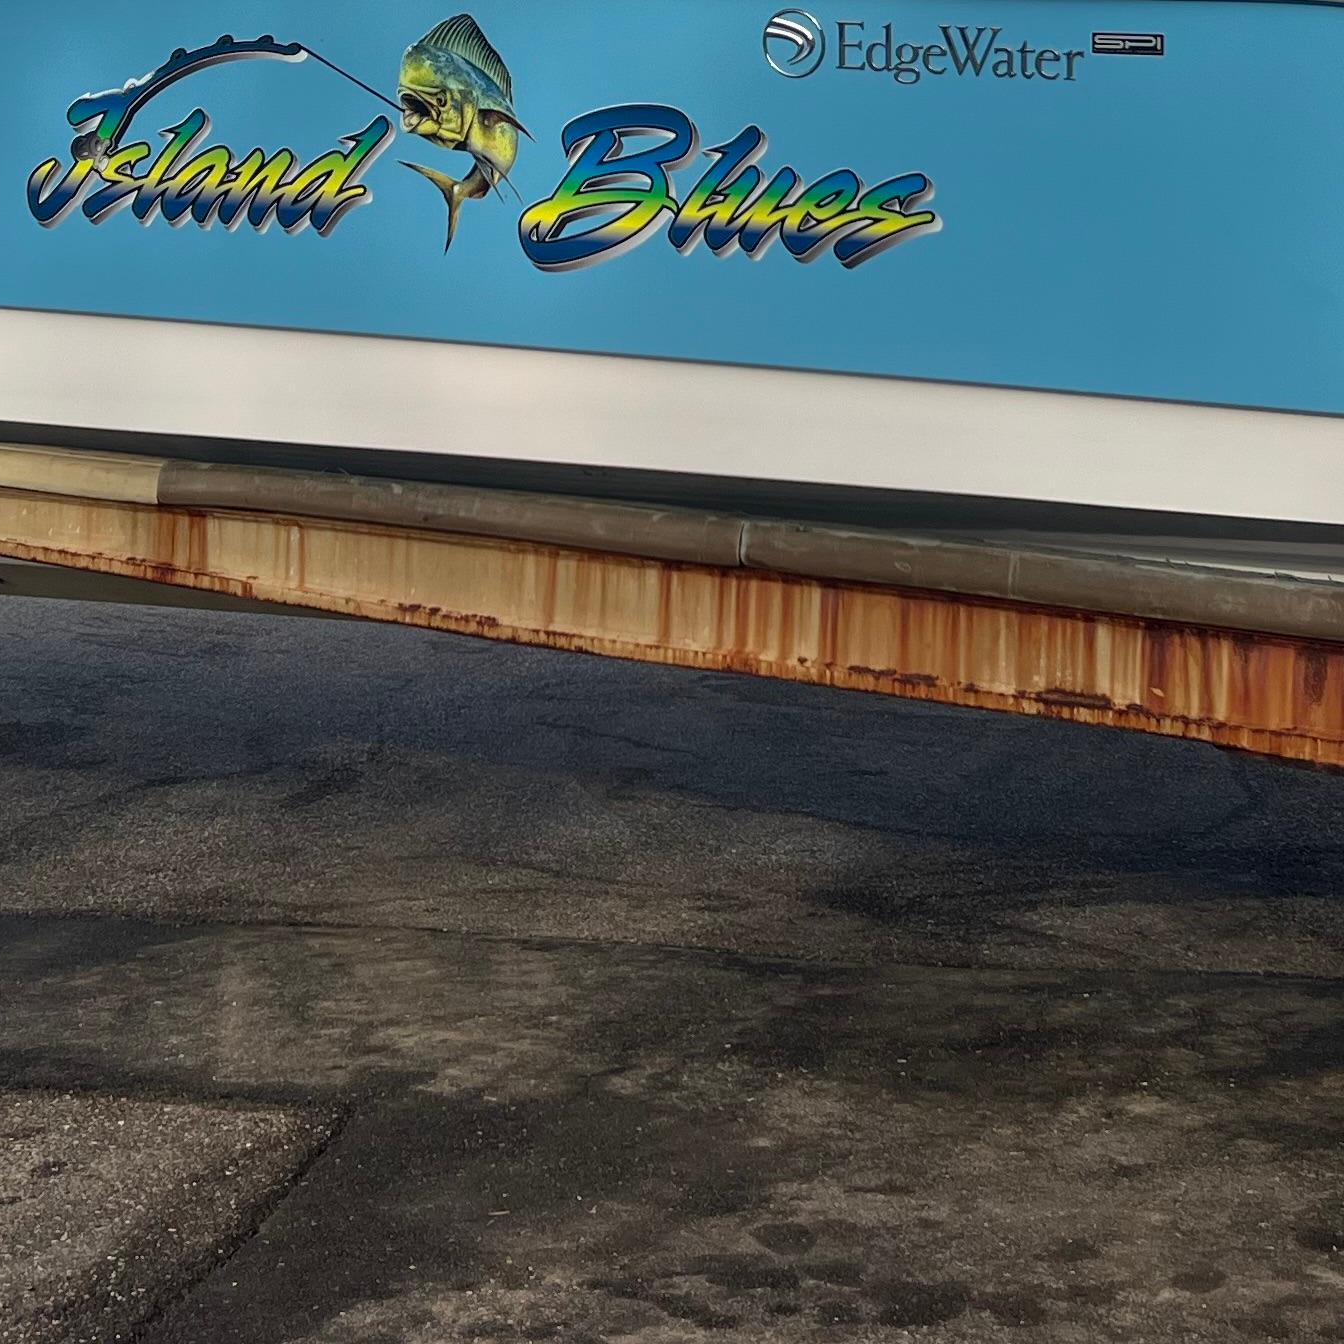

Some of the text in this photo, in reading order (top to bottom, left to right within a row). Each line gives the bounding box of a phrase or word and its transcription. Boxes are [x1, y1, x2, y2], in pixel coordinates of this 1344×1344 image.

[835, 21, 1086, 85] EdgeWater
[1094, 35, 1162, 51] SPI
[27, 86, 943, 272] Island Blues
